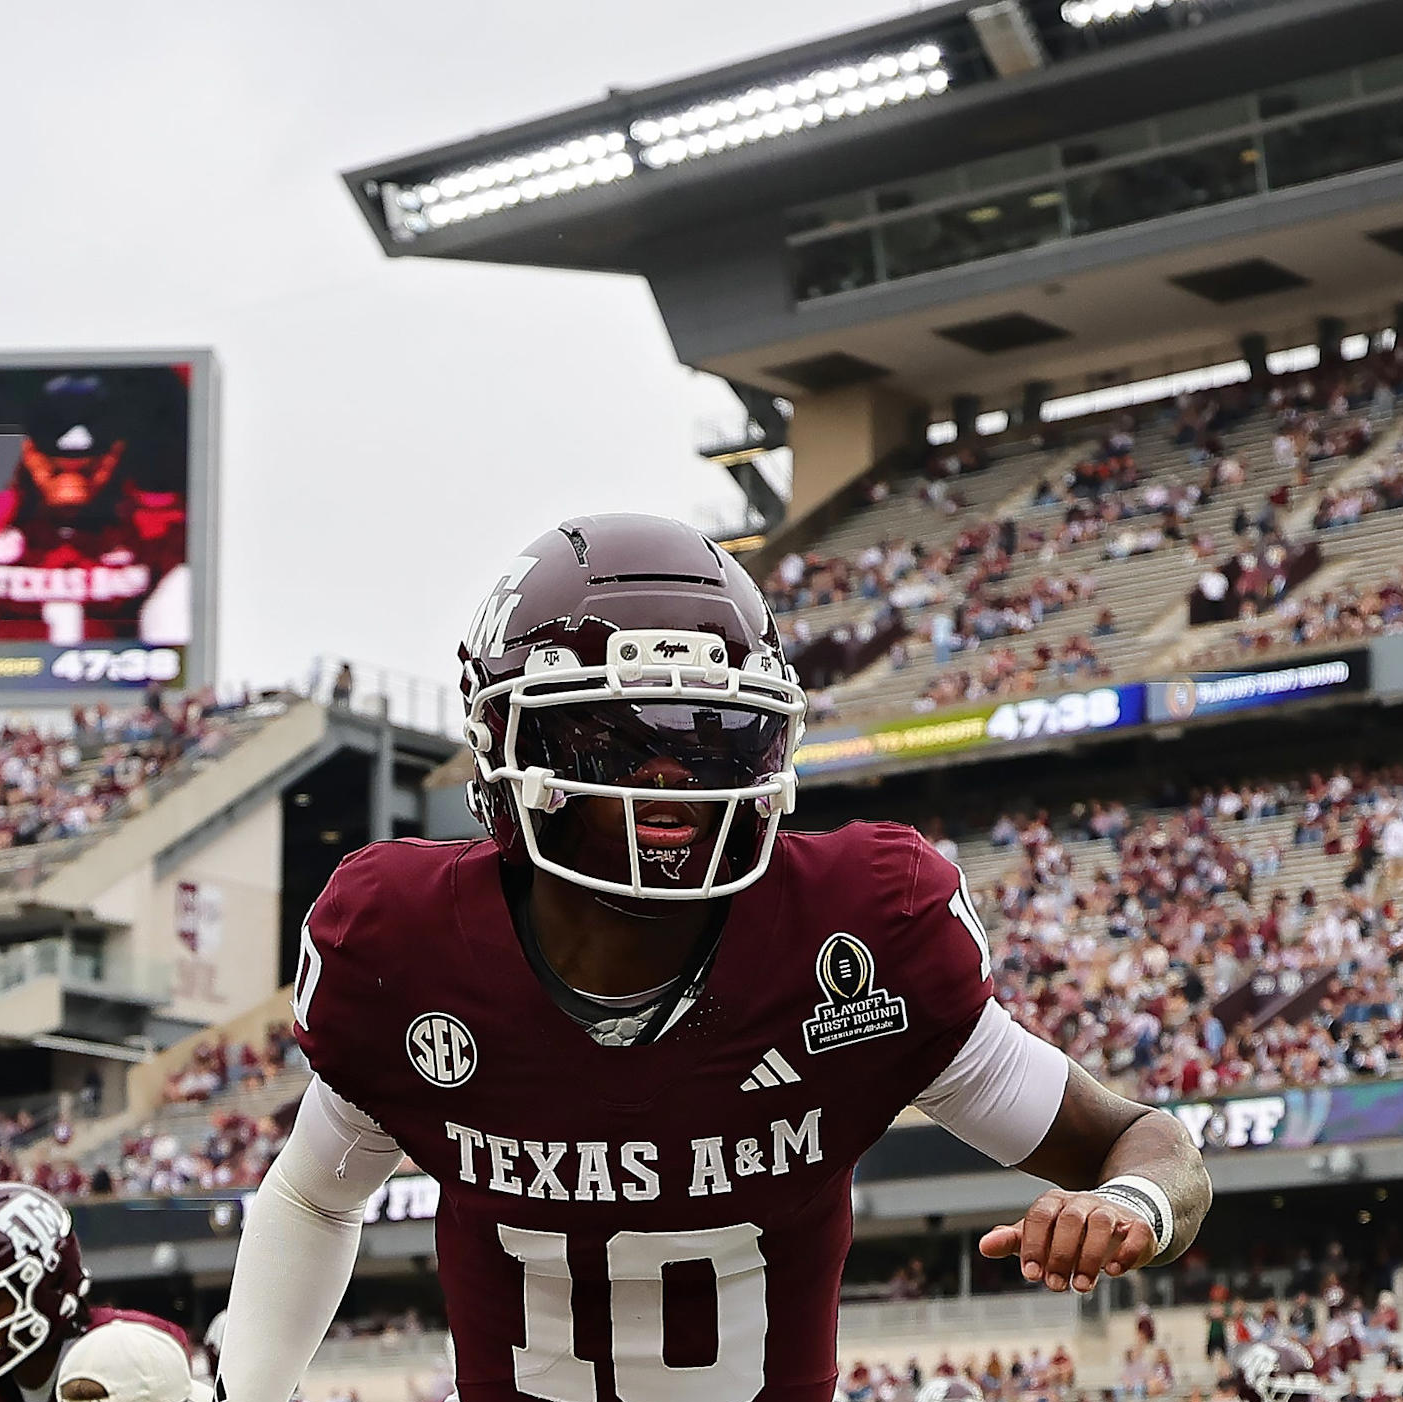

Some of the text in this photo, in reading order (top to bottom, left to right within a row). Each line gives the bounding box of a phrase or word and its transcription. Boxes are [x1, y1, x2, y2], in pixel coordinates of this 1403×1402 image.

[810, 1005, 899, 1036] FIRST ROUND
[823, 997, 882, 1020] PLAYOFF
[412, 1018, 471, 1081] SEC
[446, 1121, 660, 1201] TEXAS
[690, 1108, 824, 1198] A&M
